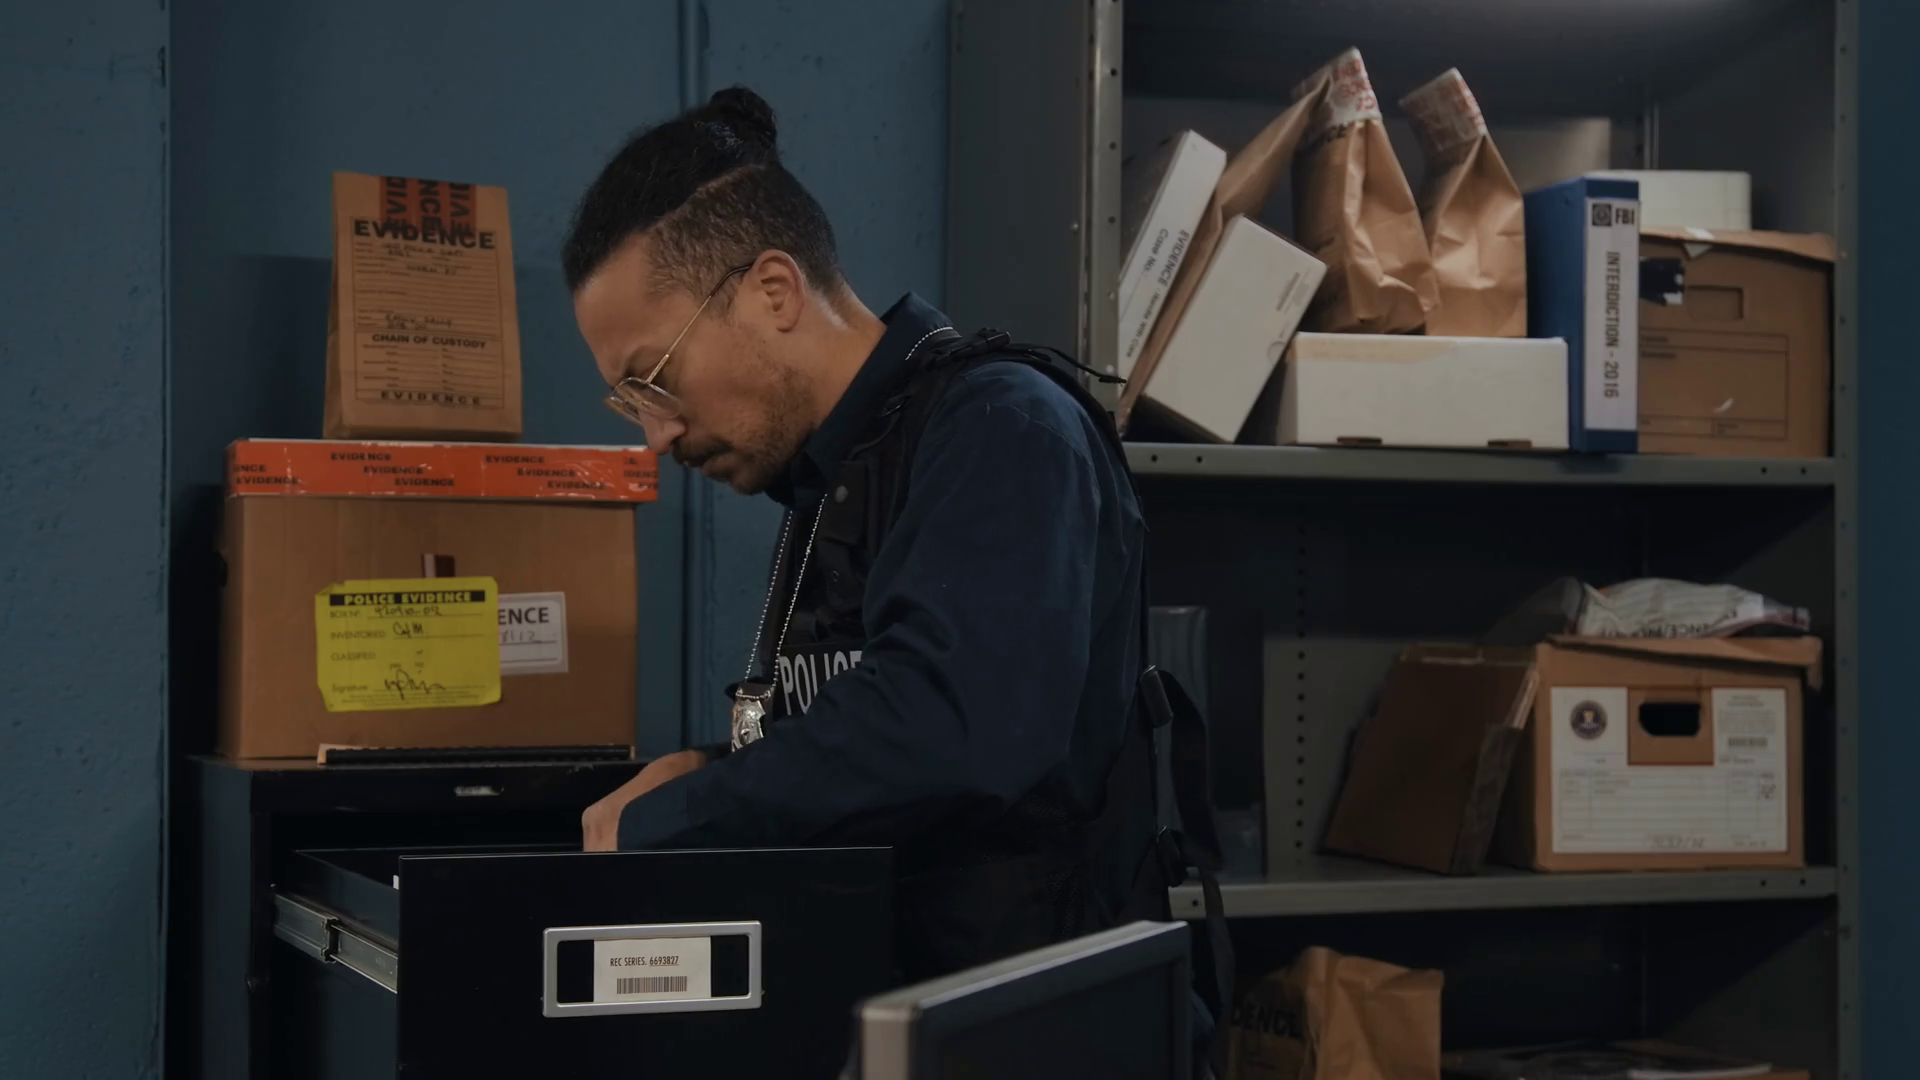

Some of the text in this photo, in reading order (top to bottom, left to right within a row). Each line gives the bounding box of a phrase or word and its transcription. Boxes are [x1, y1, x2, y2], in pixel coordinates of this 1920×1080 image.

[1615, 208, 1635, 225] FBI
[354, 219, 496, 249] EVIDENCE
[1151, 228, 1169, 258] Case
[1157, 229, 1190, 288] EVIDENCE
[1605, 252, 1621, 348] INTERDICTION
[372, 333, 487, 349] CHAIN OF CUSTODY
[1603, 361, 1619, 399] 2016
[381, 391, 481, 407] EVIDENCE
[331, 452, 391, 461] EVIDENCE
[485, 455, 544, 464] EVIDENCE
[363, 465, 424, 475] EVIDENCE
[517, 467, 576, 477] EVIDENCE
[236, 475, 299, 485] EVIDENCE
[395, 477, 455, 487] EVIDENCE
[548, 479, 605, 490] EVIDENCE
[344, 591, 472, 606] POLICE EVIDENCE
[609, 956, 680, 967] REC SERIES. 6693827
